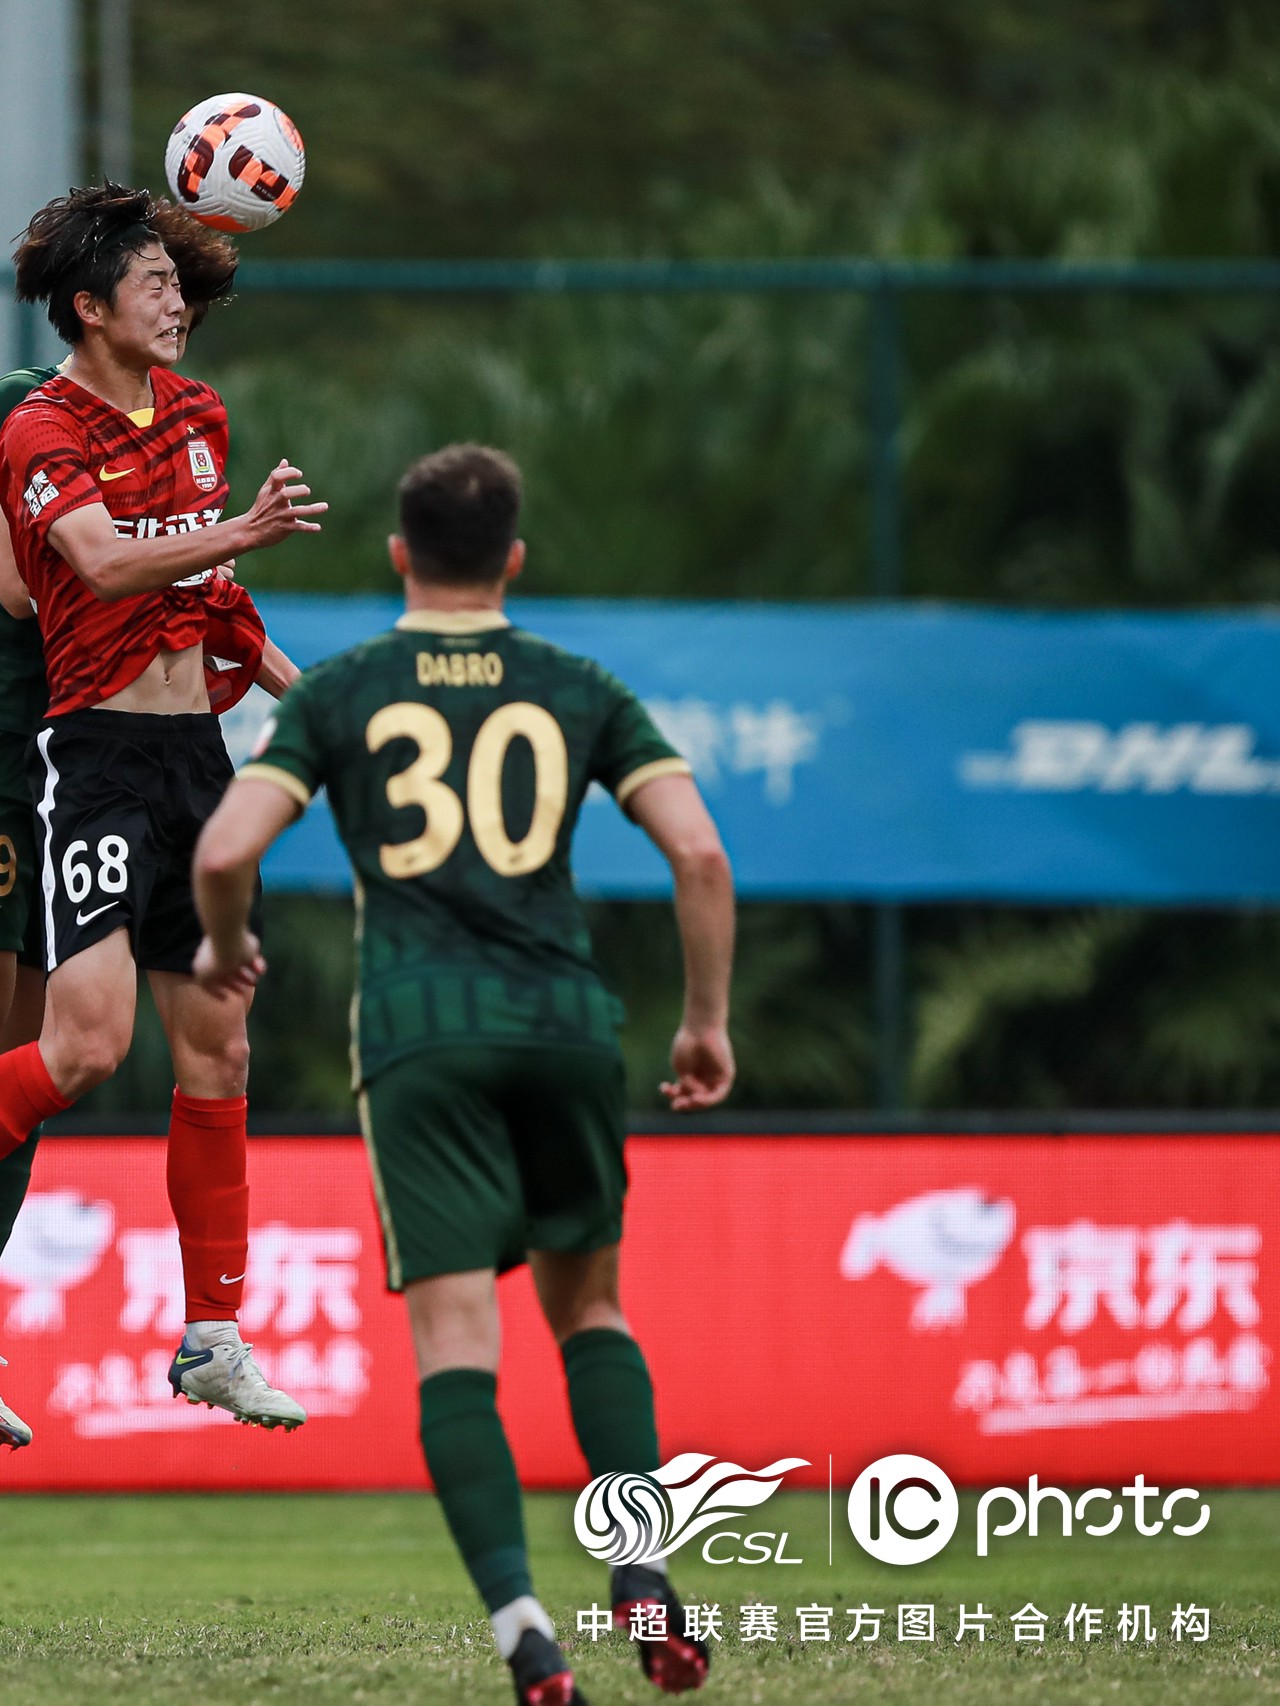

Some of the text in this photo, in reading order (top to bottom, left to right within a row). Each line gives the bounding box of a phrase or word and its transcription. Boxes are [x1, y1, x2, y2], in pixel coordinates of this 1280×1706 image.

[416, 651, 504, 689] DABRO
[365, 701, 569, 879] 30
[62, 834, 130, 904] 68
[1022, 1220, 1262, 1331] 京东
